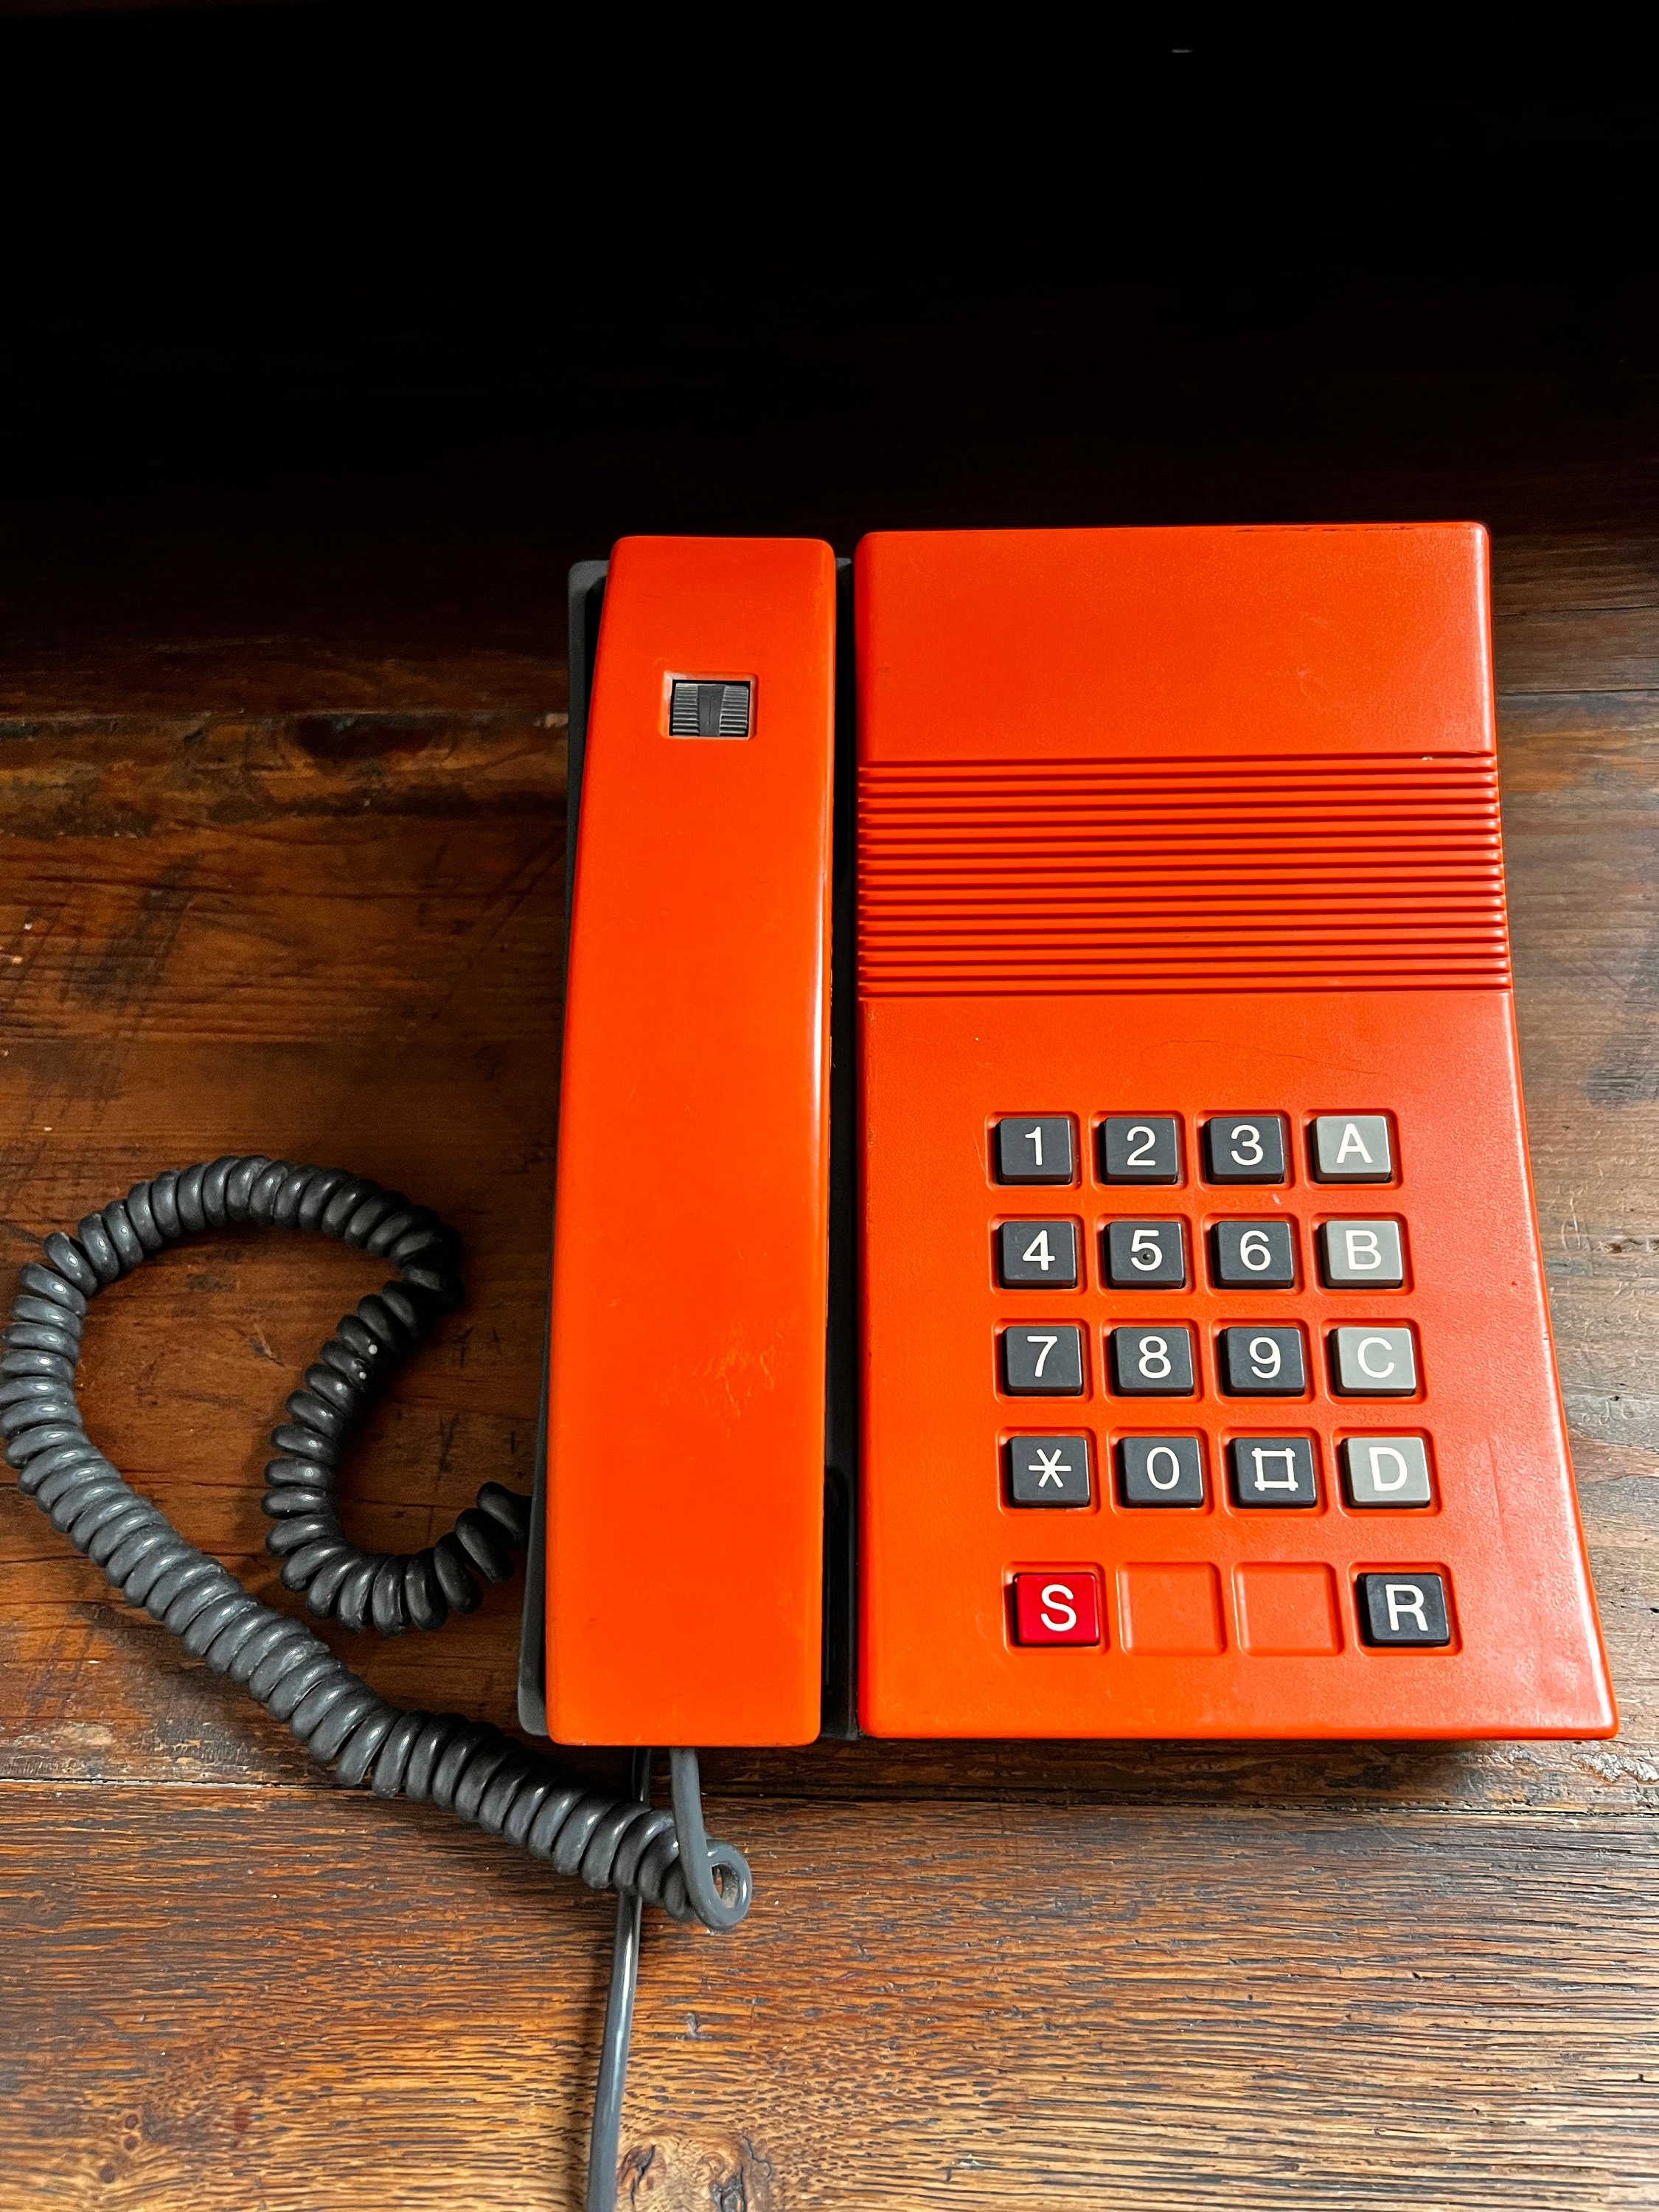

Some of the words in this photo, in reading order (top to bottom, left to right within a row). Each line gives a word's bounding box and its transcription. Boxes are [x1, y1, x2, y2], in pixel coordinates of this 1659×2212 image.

[1024, 1127, 1043, 1166] 1
[1127, 1127, 1156, 1166] 2
[1231, 1124, 1264, 1166] 3
[1336, 1123, 1373, 1164] A
[1022, 1230, 1055, 1270] 4
[1130, 1229, 1163, 1271] 5
[1240, 1230, 1271, 1271] 6
[1345, 1229, 1382, 1270] B
[1027, 1336, 1058, 1377] 7
[1138, 1336, 1172, 1379] 8
[1249, 1337, 1281, 1379] 9
[1357, 1337, 1395, 1379] C
[1147, 1447, 1180, 1490] 0
[1368, 1447, 1408, 1492] D
[1040, 1584, 1077, 1632] S
[1385, 1584, 1428, 1632] R
